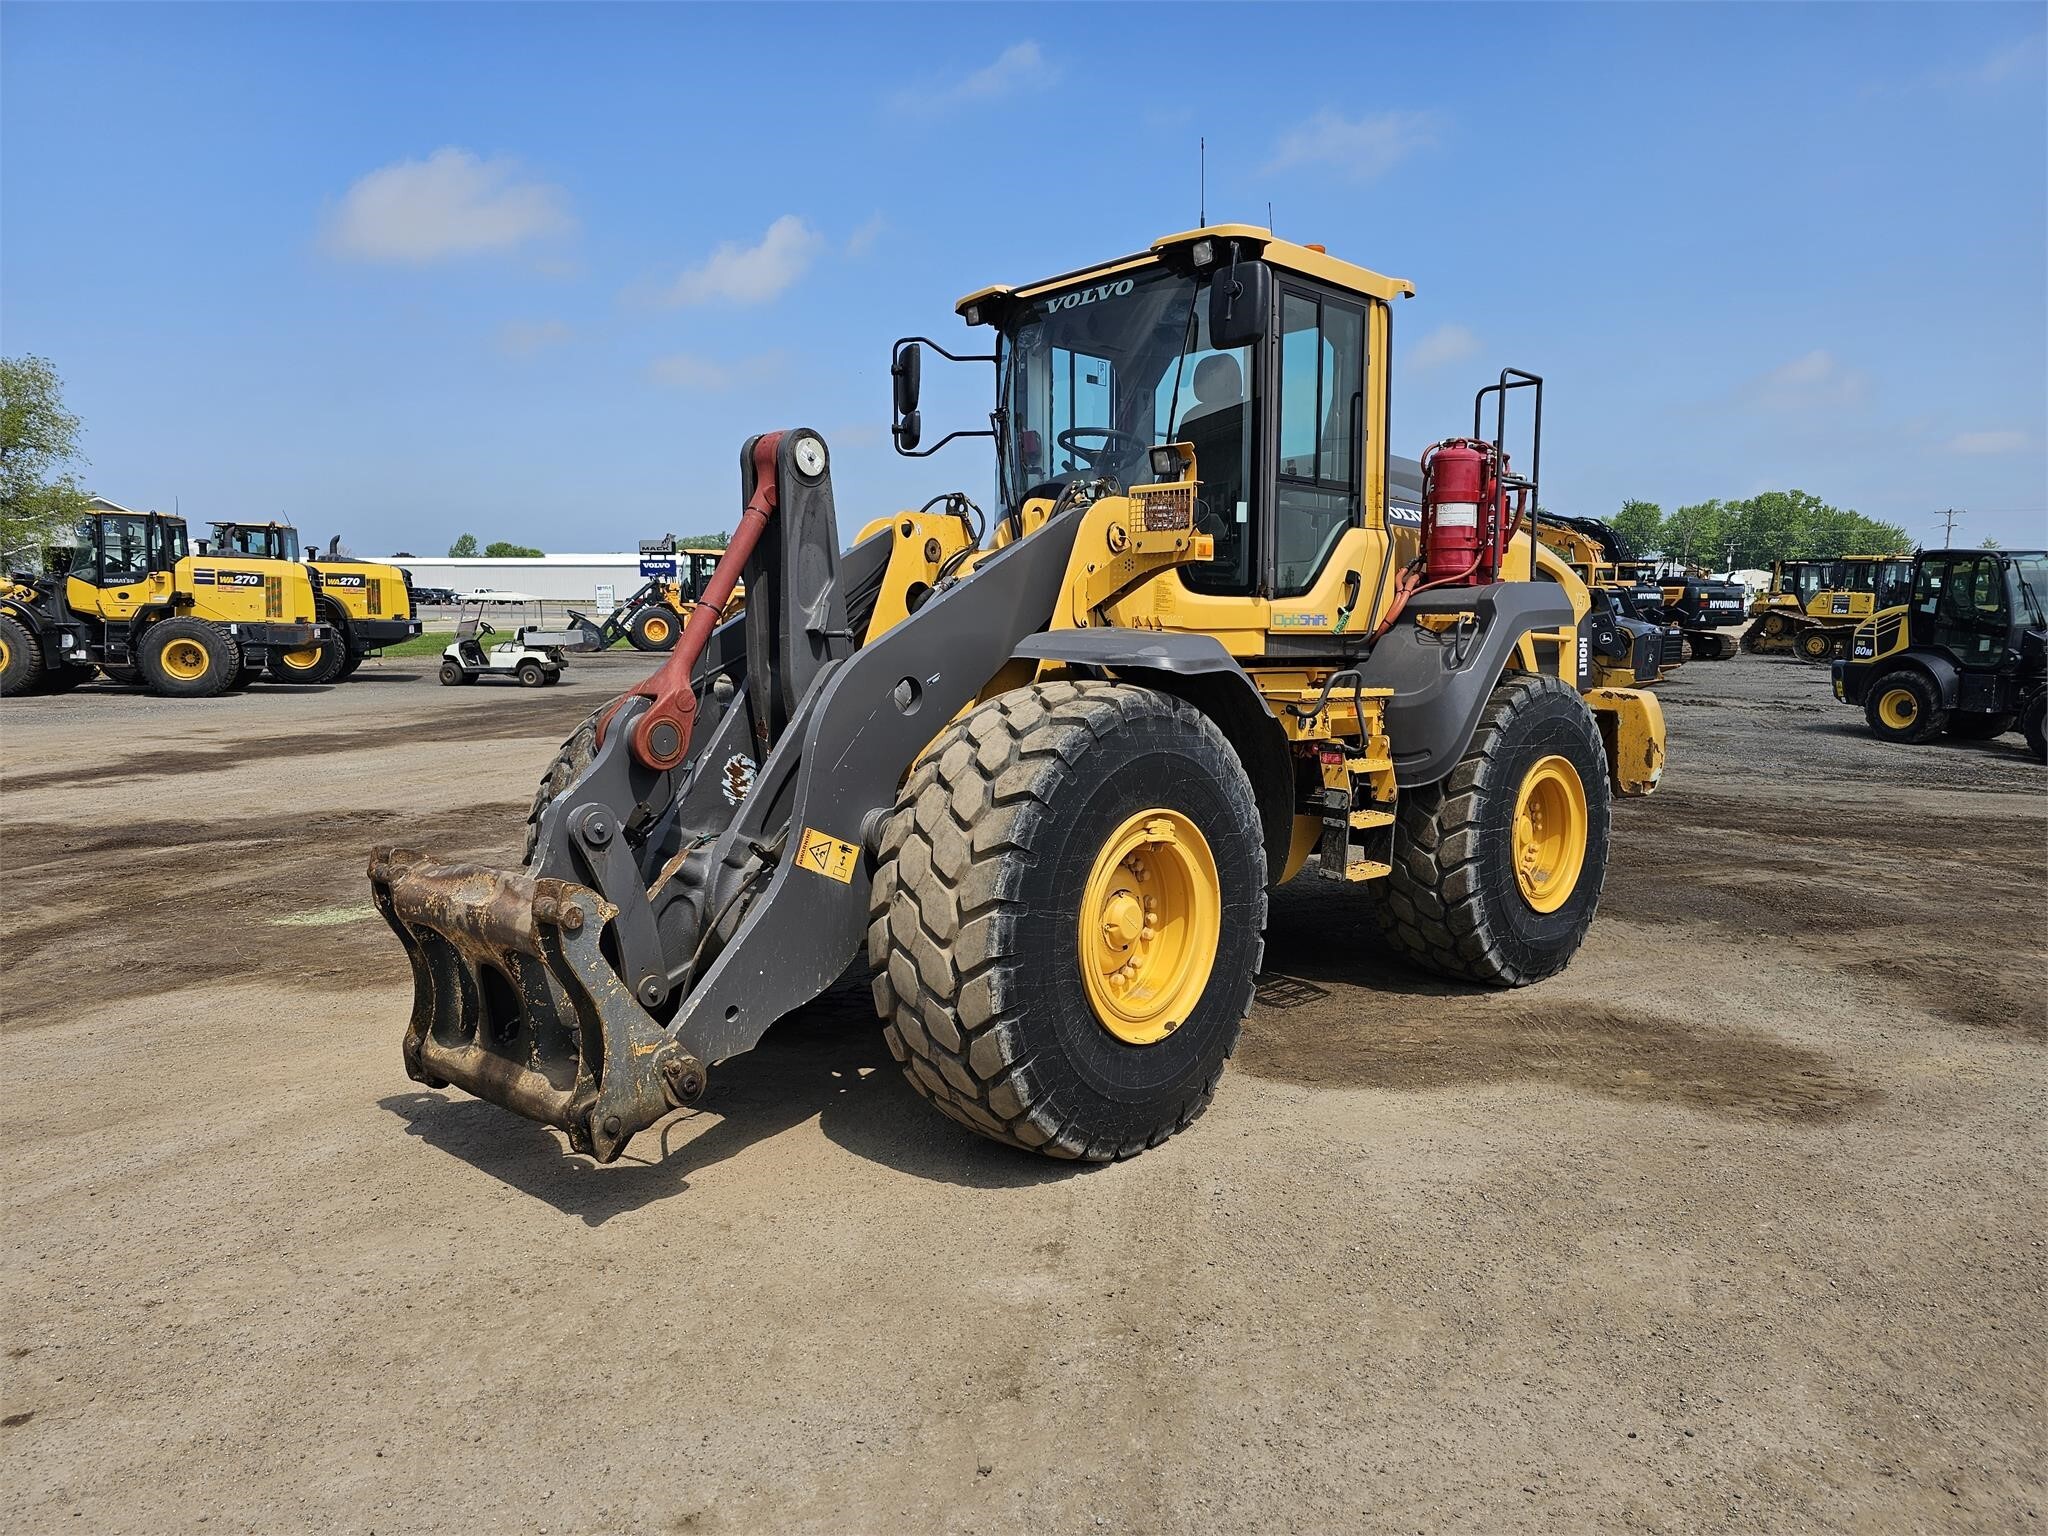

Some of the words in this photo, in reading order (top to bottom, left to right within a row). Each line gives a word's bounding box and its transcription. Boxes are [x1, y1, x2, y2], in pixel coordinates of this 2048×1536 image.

[1045, 279, 1134, 314] VOLVO
[1389, 506, 1422, 522] OLV
[219, 575, 259, 585] WA270
[327, 577, 360, 586] WA270
[1709, 600, 1740, 609] HYUNDAI
[1273, 614, 1328, 627] OptiShift
[1579, 637, 1588, 676] L110H
[1854, 646, 1873, 656] 80M
[800, 829, 812, 861] WARNING
